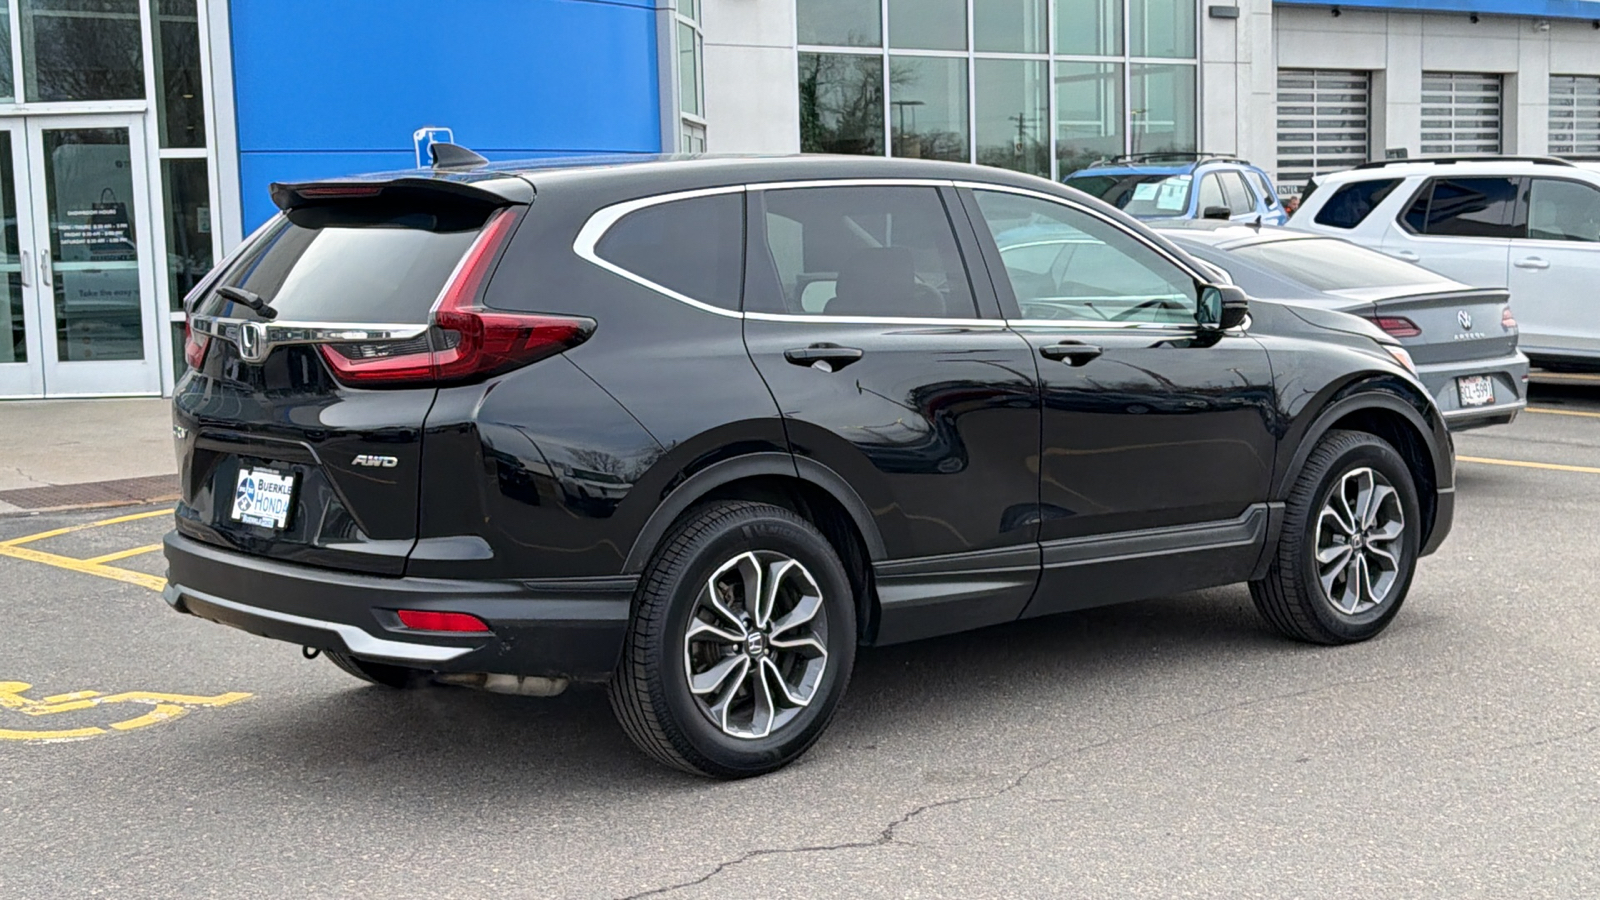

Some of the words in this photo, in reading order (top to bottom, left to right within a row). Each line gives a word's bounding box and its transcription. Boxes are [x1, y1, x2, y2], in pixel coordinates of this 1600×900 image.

[79, 289, 98, 297] Take
[100, 288, 113, 296] the
[351, 454, 398, 467] AWD
